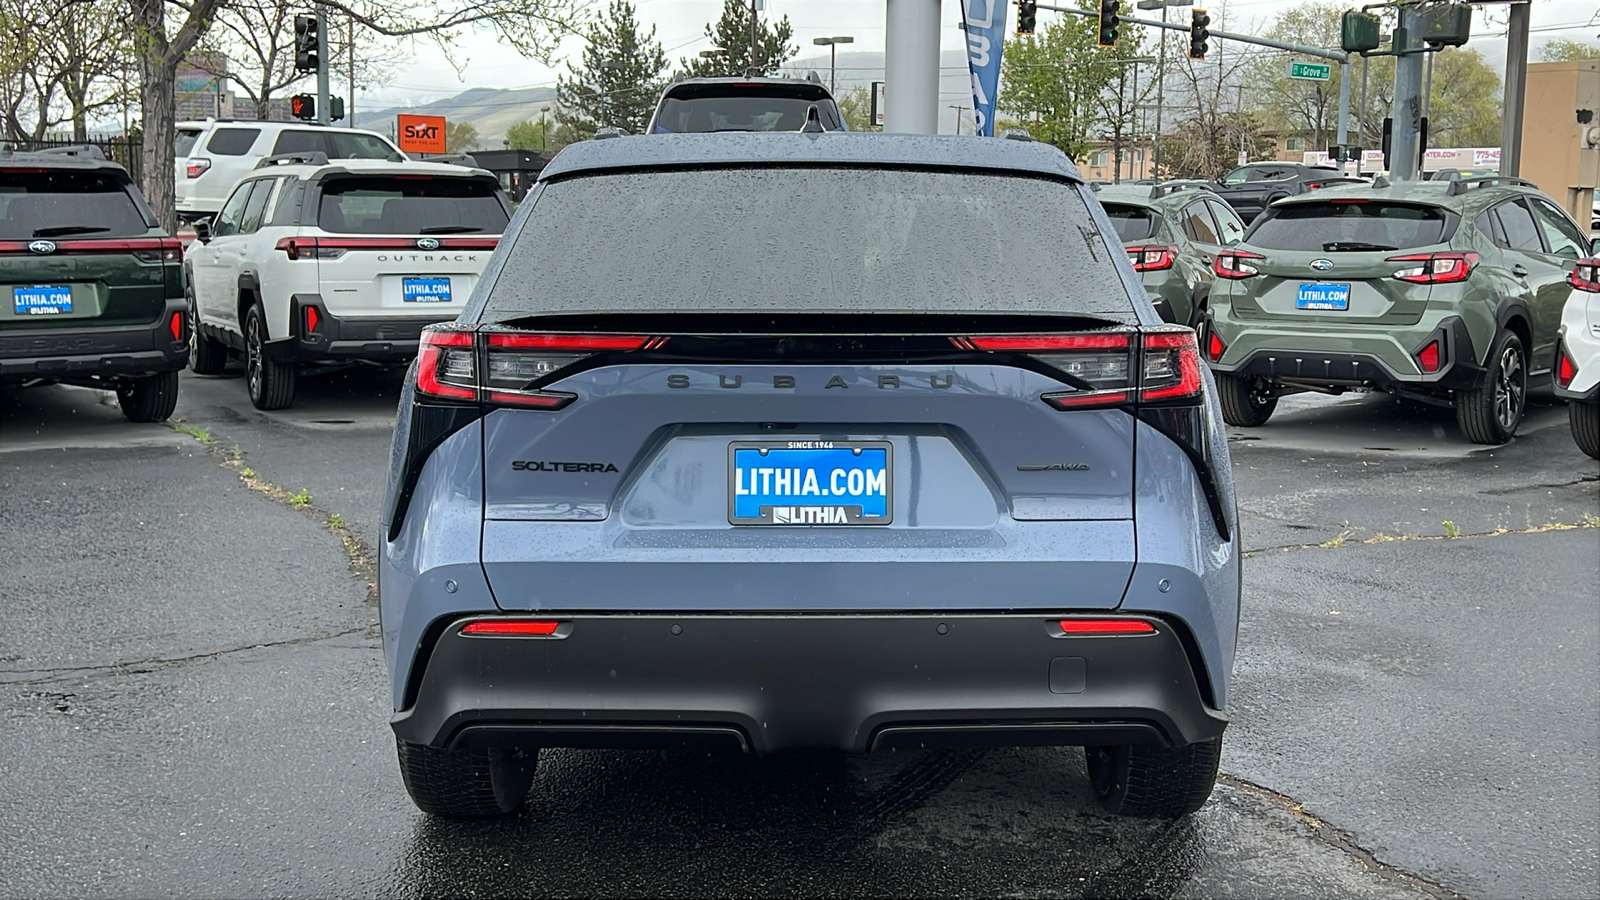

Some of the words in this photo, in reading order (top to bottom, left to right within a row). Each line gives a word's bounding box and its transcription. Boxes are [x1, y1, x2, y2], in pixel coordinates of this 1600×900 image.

[1303, 66, 1321, 77] Grove
[404, 284, 450, 295] LITHIA.COM
[15, 293, 72, 306] LITHIA.COM
[1299, 290, 1347, 302] LITHIA.COM
[37, 307, 60, 315] LITHIA
[667, 374, 953, 389] SUBARU
[787, 441, 813, 449] SINCE
[814, 441, 834, 449] 1946
[511, 460, 619, 473] SOLTERRA
[735, 468, 887, 496] LITHIA.COM
[789, 506, 848, 524] LITHIA
